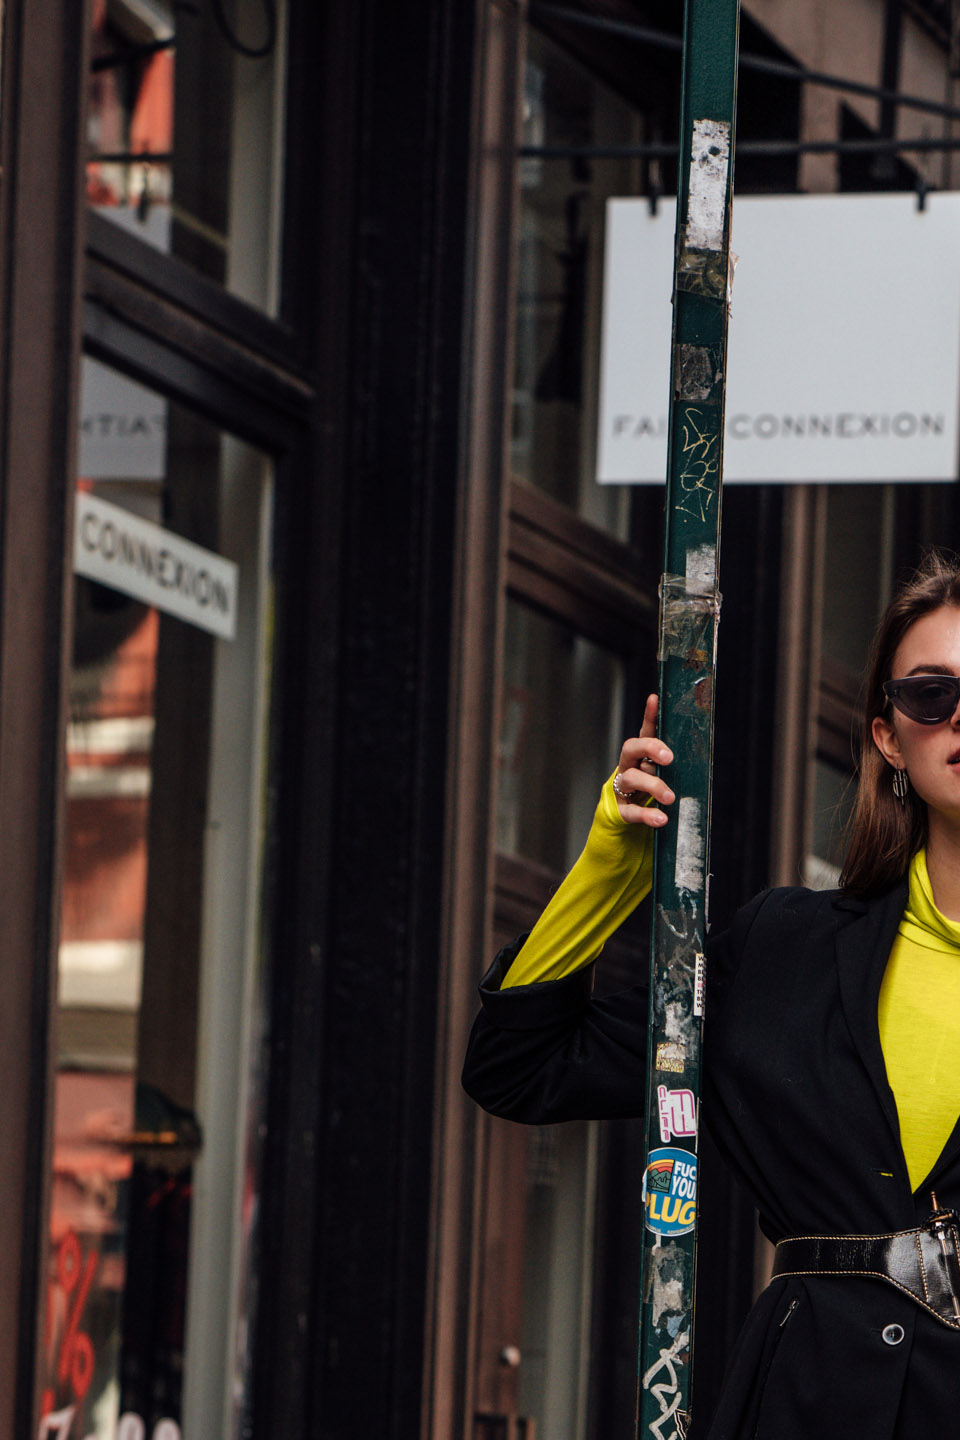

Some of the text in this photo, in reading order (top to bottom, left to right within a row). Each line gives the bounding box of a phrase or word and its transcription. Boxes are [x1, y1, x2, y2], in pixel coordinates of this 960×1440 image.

[611, 411, 945, 440] FAI CONNEXION
[81, 511, 229, 613] CONNEXION
[674, 1160, 697, 1180] FUC
